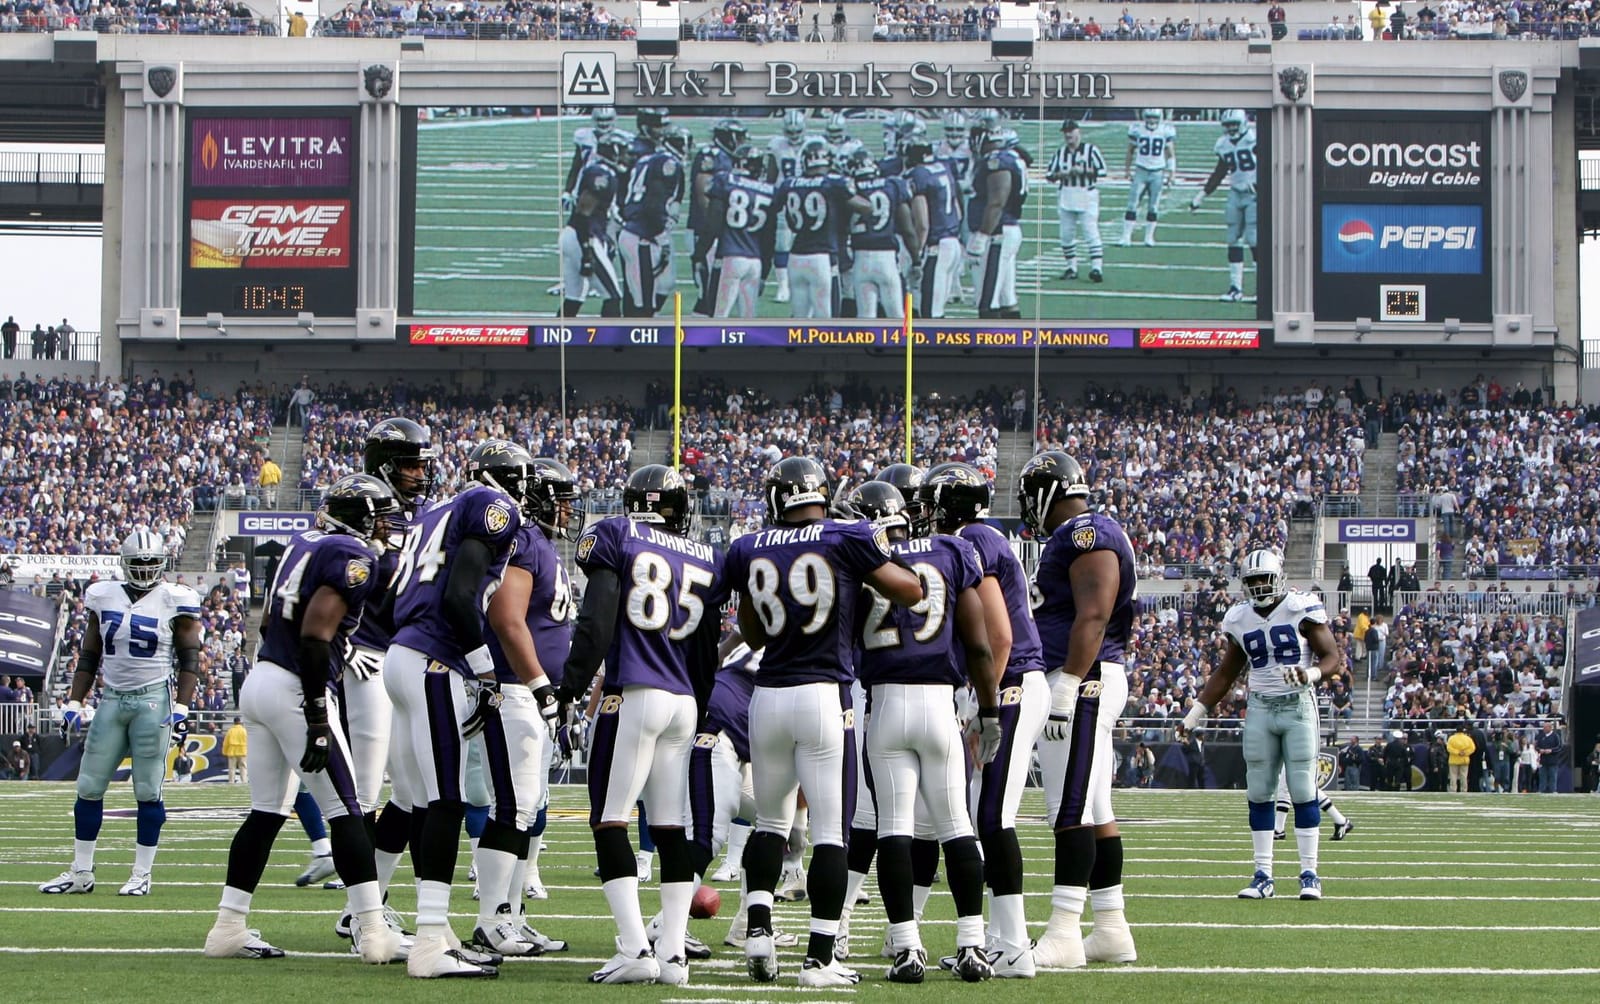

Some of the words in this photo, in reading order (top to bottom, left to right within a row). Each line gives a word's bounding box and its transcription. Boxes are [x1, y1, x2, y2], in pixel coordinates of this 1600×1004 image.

[633, 61, 744, 98] M&T
[765, 61, 892, 98] Bank
[909, 62, 1115, 99] Stadium
[224, 136, 344, 155] LEVITRA
[1325, 141, 1480, 167] comcast
[224, 158, 296, 170] (VARDENAFIL
[1369, 171, 1428, 187] Digital
[1432, 172, 1480, 185] Cable
[221, 205, 345, 224] GAME
[726, 189, 772, 232] 85
[233, 227, 329, 245] TIME
[1380, 226, 1476, 249] PEPSI
[222, 247, 341, 257] BUDWEISER
[244, 286, 304, 309] 10:43
[1387, 291, 1418, 315] 25
[428, 327, 483, 336] GAME
[485, 327, 528, 336] TIME
[543, 328, 572, 343] IND
[587, 328, 597, 343] 7
[630, 328, 659, 343] CHI
[882, 330, 900, 344] 14
[936, 332, 971, 345] PASS
[976, 332, 1016, 345] FROM
[1158, 331, 1213, 339] GAME
[1216, 331, 1258, 339] TIME
[244, 518, 309, 531] GEICO
[1345, 524, 1409, 537] GEICO
[630, 520, 644, 540] K.
[647, 528, 714, 564] JOHNSON
[60, 556, 98, 566] CROWS
[626, 551, 714, 641] 85
[748, 552, 835, 638] 89
[862, 562, 946, 651] 29
[101, 610, 159, 658] 75
[1243, 624, 1301, 668] 98
